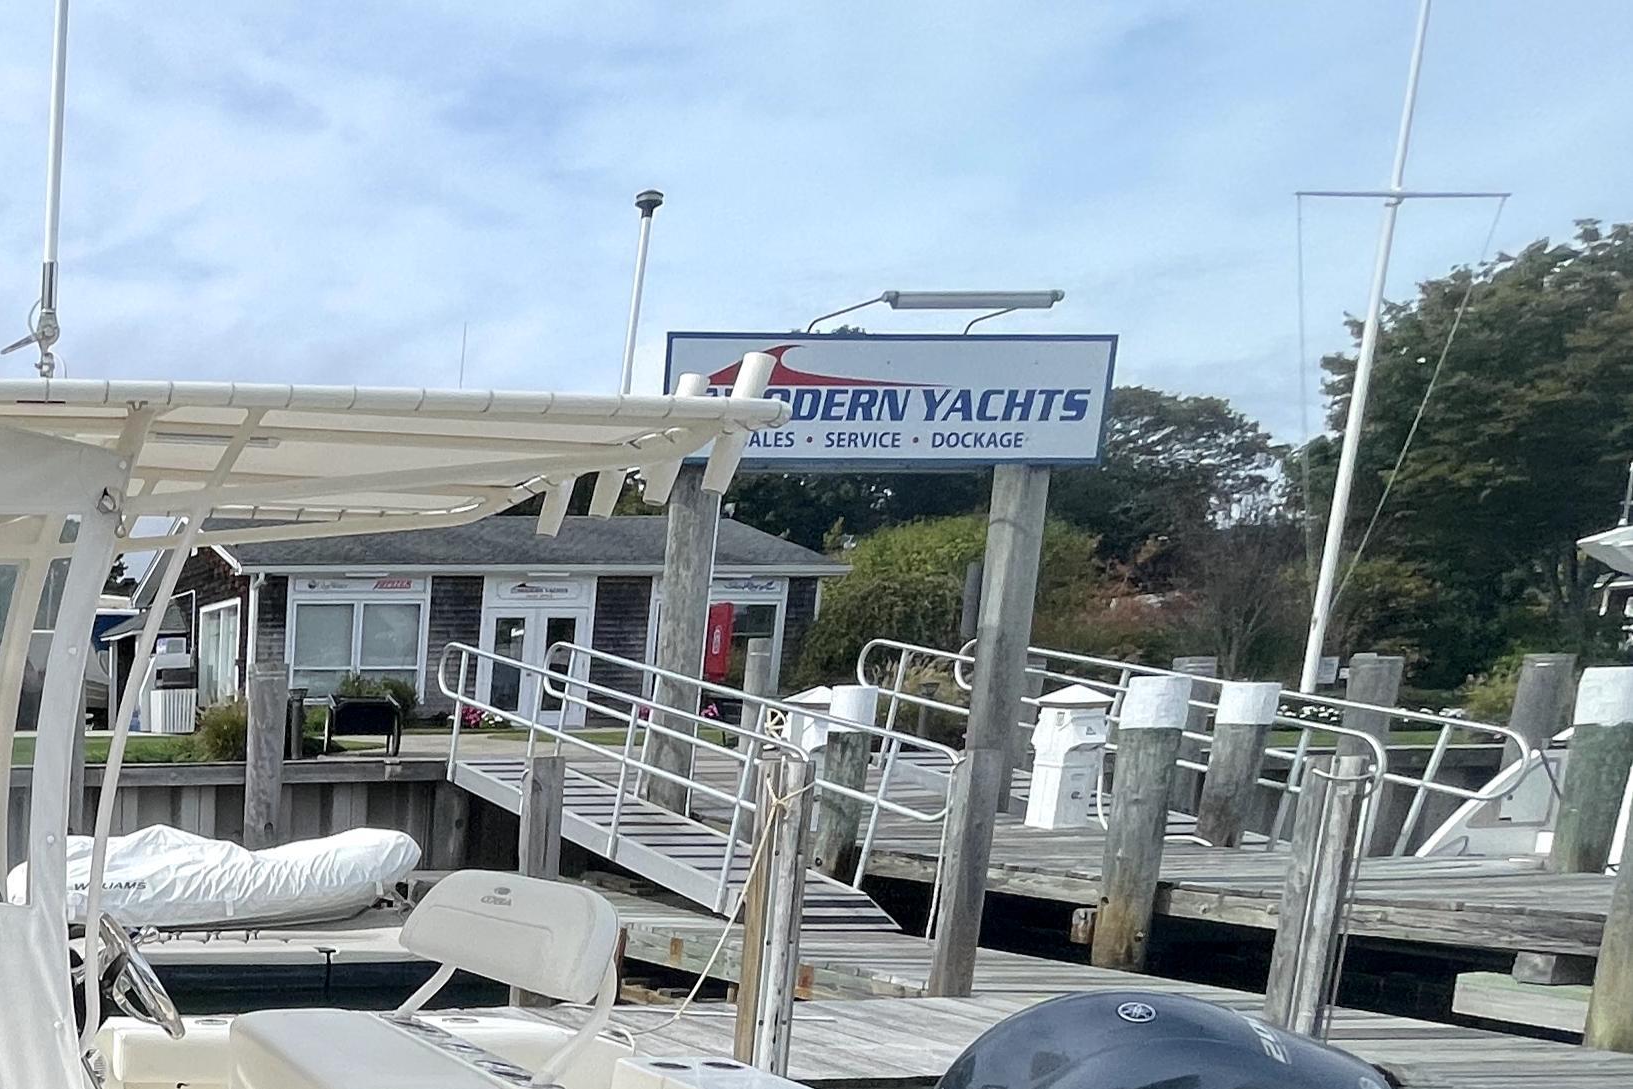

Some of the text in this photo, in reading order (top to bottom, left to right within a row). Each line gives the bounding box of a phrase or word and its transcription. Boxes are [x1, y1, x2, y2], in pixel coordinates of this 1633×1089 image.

[922, 388, 1091, 422] YACHTS
[745, 431, 1025, 448] ALES SERVICE DOCKAGE
[74, 881, 147, 891] WLIAMS
